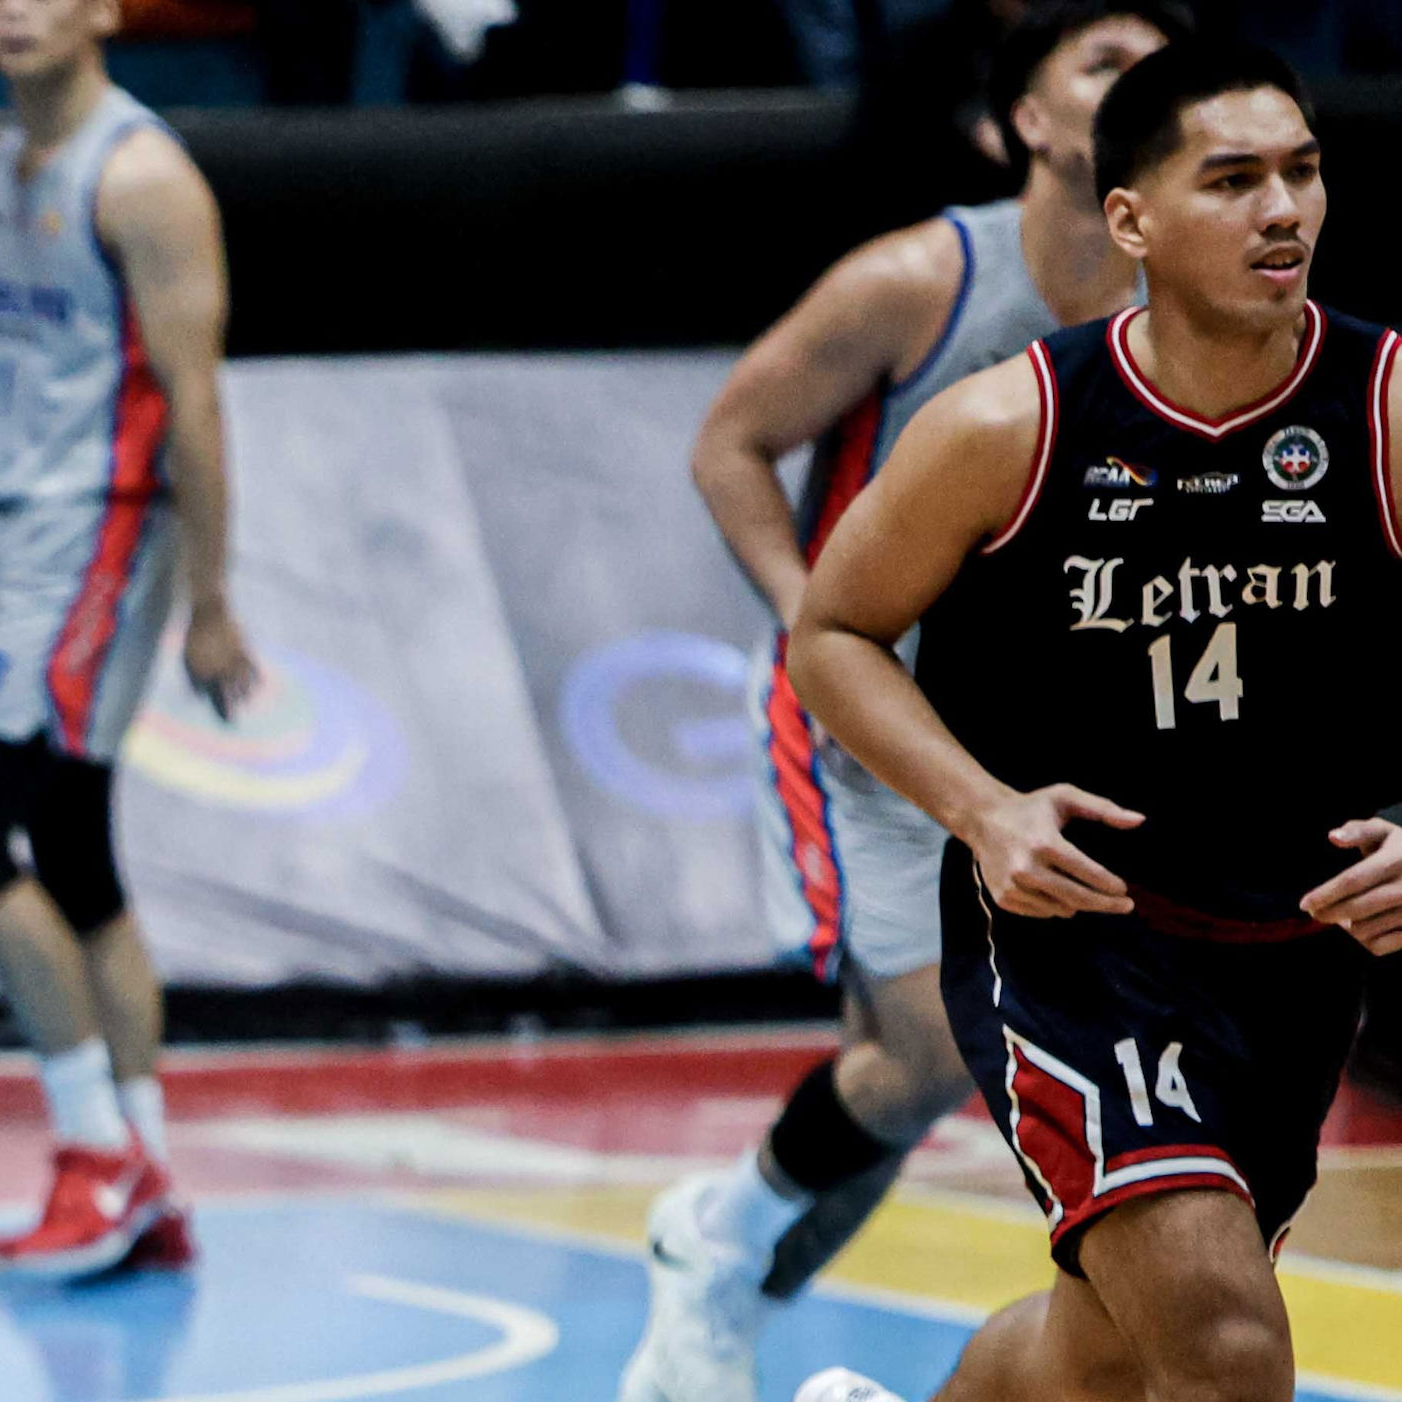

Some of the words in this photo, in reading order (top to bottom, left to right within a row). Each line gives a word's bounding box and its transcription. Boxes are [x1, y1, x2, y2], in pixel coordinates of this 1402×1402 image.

[1261, 500, 1326, 522] SGA
[1064, 555, 1336, 633] Letran
[1147, 622, 1244, 729] 14
[1114, 1038, 1202, 1127] 14
